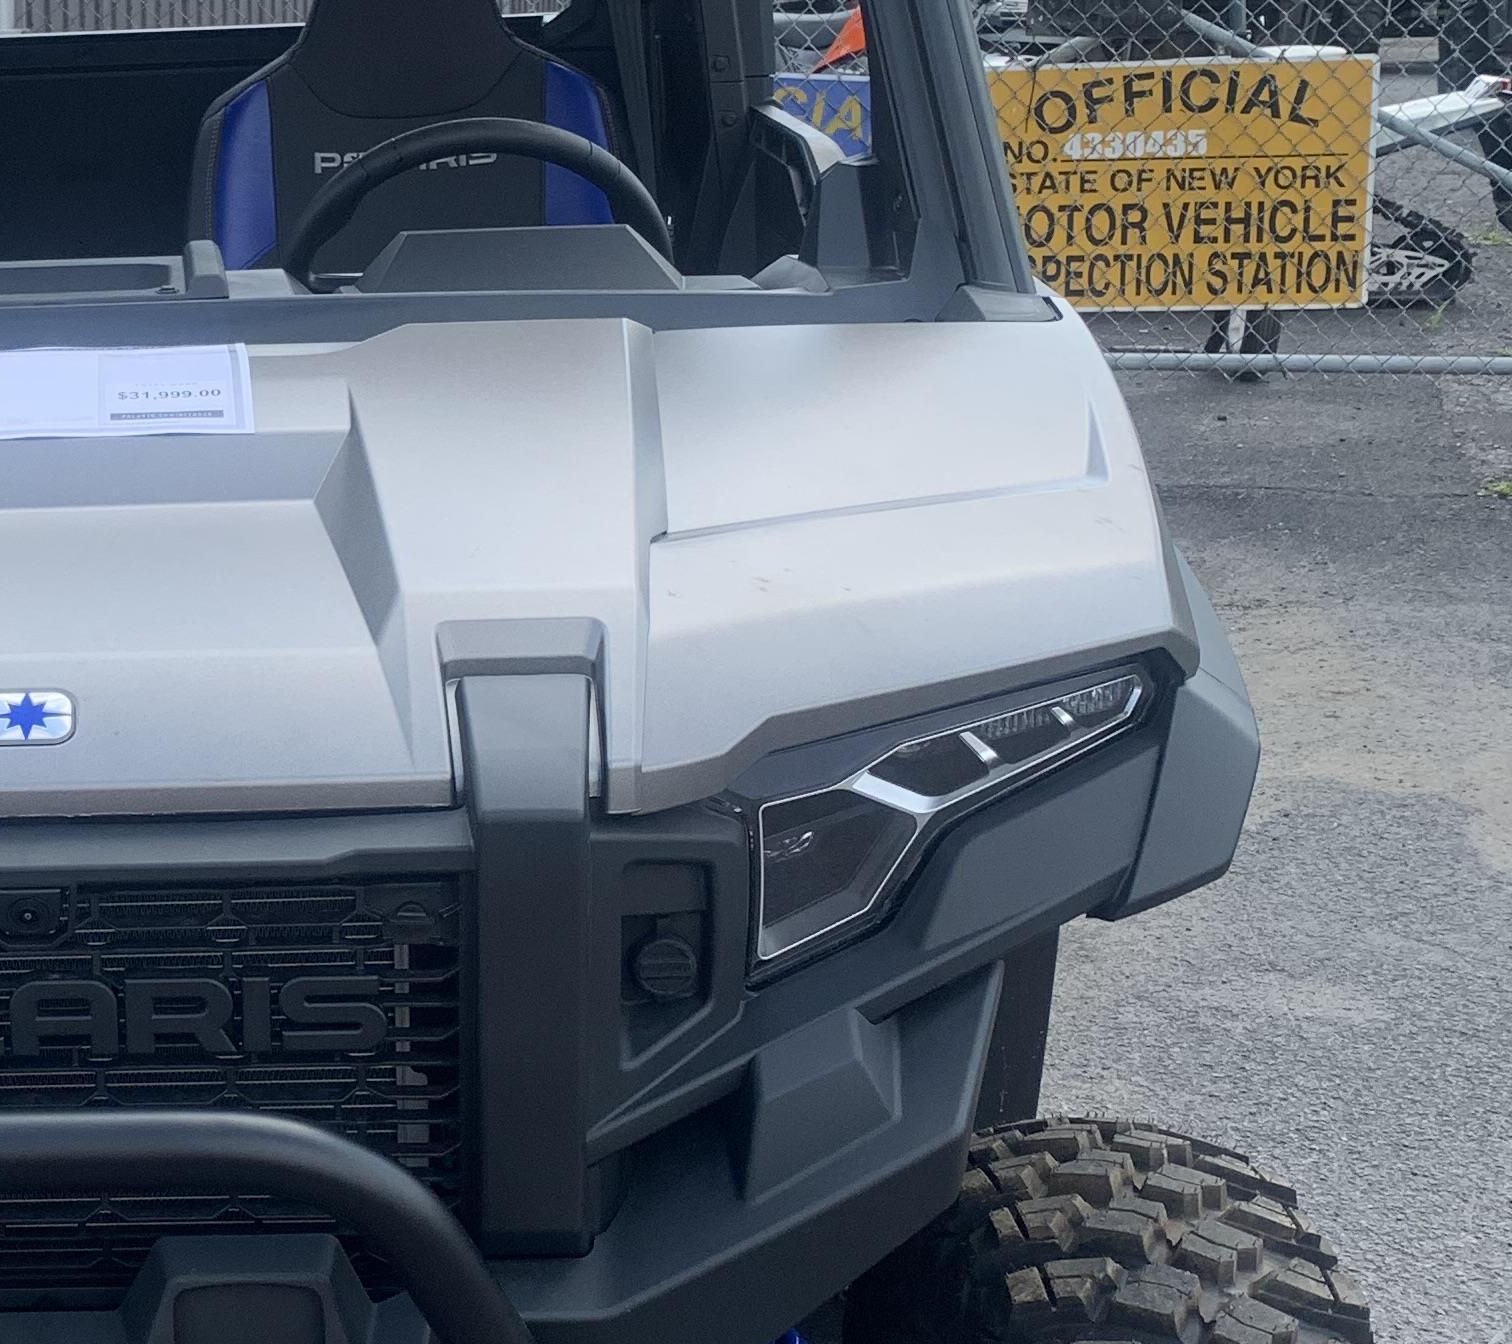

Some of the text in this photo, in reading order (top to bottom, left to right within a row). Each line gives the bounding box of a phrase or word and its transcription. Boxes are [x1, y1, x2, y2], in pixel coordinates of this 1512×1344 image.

[1033, 68, 1320, 135] OFFICIAL
[314, 151, 498, 174] PRIS
[1003, 139, 1059, 164] NO.
[1110, 167, 1154, 193] OF
[1165, 166, 1240, 192] NEW
[1252, 163, 1347, 191] YORK
[1018, 198, 1358, 248] OTOR VEHICLE
[1028, 249, 1359, 299] PECTION STATION
[117, 388, 222, 401] $31,999.00
